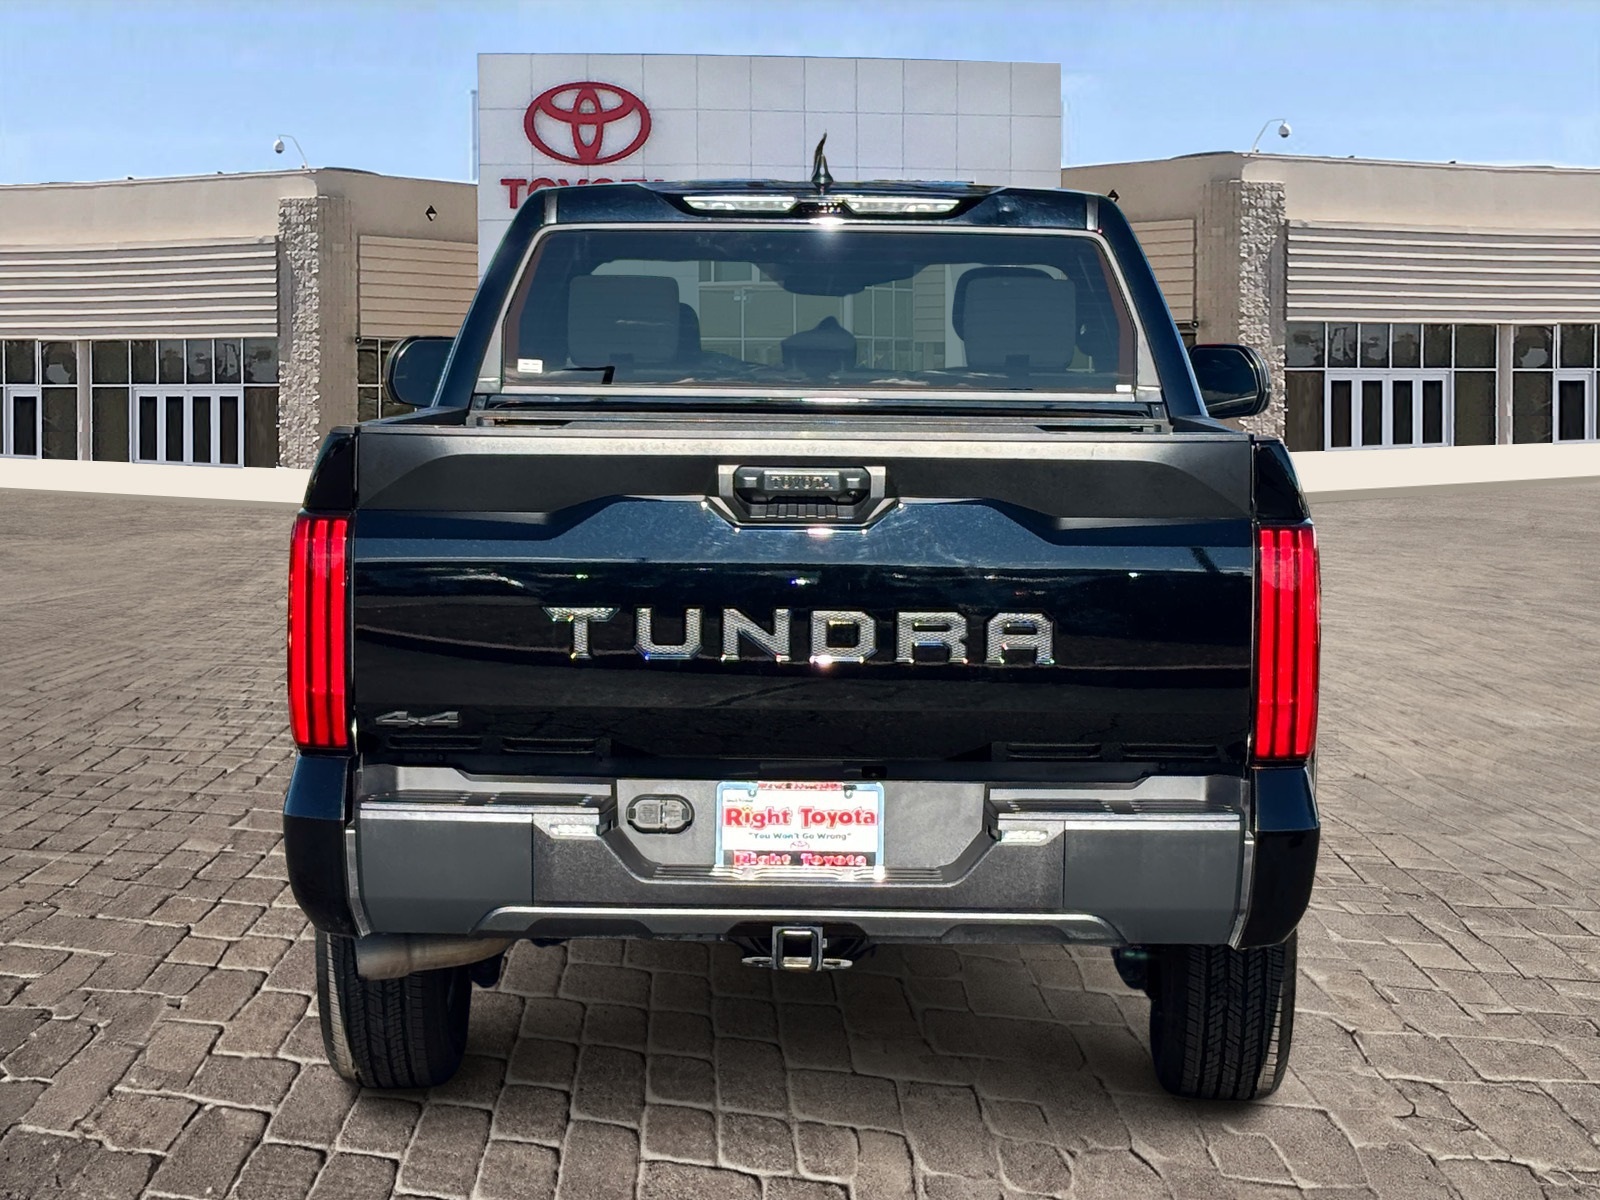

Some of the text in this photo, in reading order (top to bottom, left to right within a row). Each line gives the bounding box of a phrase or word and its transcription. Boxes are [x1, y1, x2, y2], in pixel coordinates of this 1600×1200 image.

[542, 606, 1056, 665] TUNDRA
[375, 710, 459, 728] 4x4
[724, 806, 877, 829] Right Toyota
[748, 832, 852, 841] "You Won't Go Wrong"
[734, 851, 867, 866] Right Toyota
